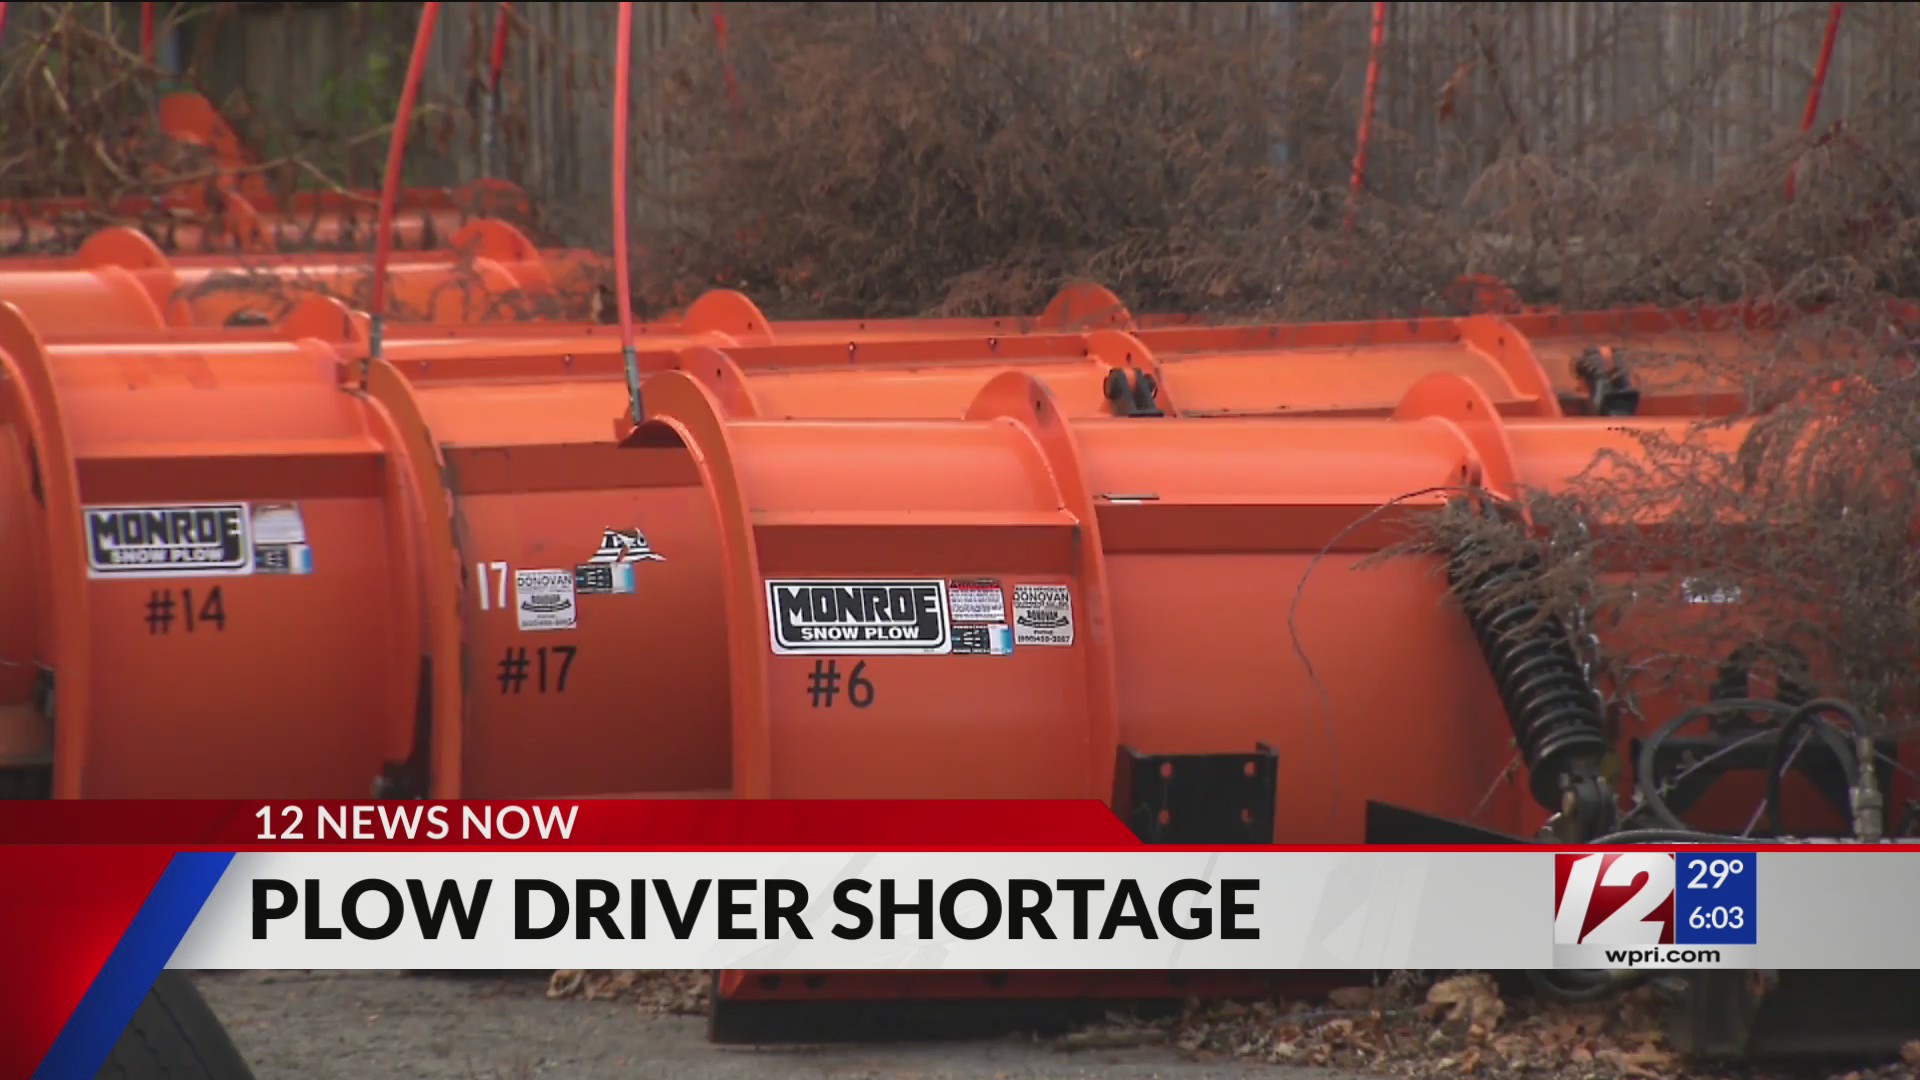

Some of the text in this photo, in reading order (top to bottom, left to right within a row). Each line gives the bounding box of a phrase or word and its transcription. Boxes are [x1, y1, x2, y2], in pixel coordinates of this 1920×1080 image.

[91, 509, 240, 546] MONROE
[111, 548, 224, 563] SNOW PLOW
[477, 561, 508, 610] 17
[517, 575, 572, 587] DONOVAN
[1013, 591, 1069, 602] DONOVAN
[145, 586, 225, 634] #14
[777, 587, 937, 623] MONROE
[801, 627, 919, 640] SNOW PLOW
[497, 645, 577, 694] #17
[807, 660, 875, 708] #6
